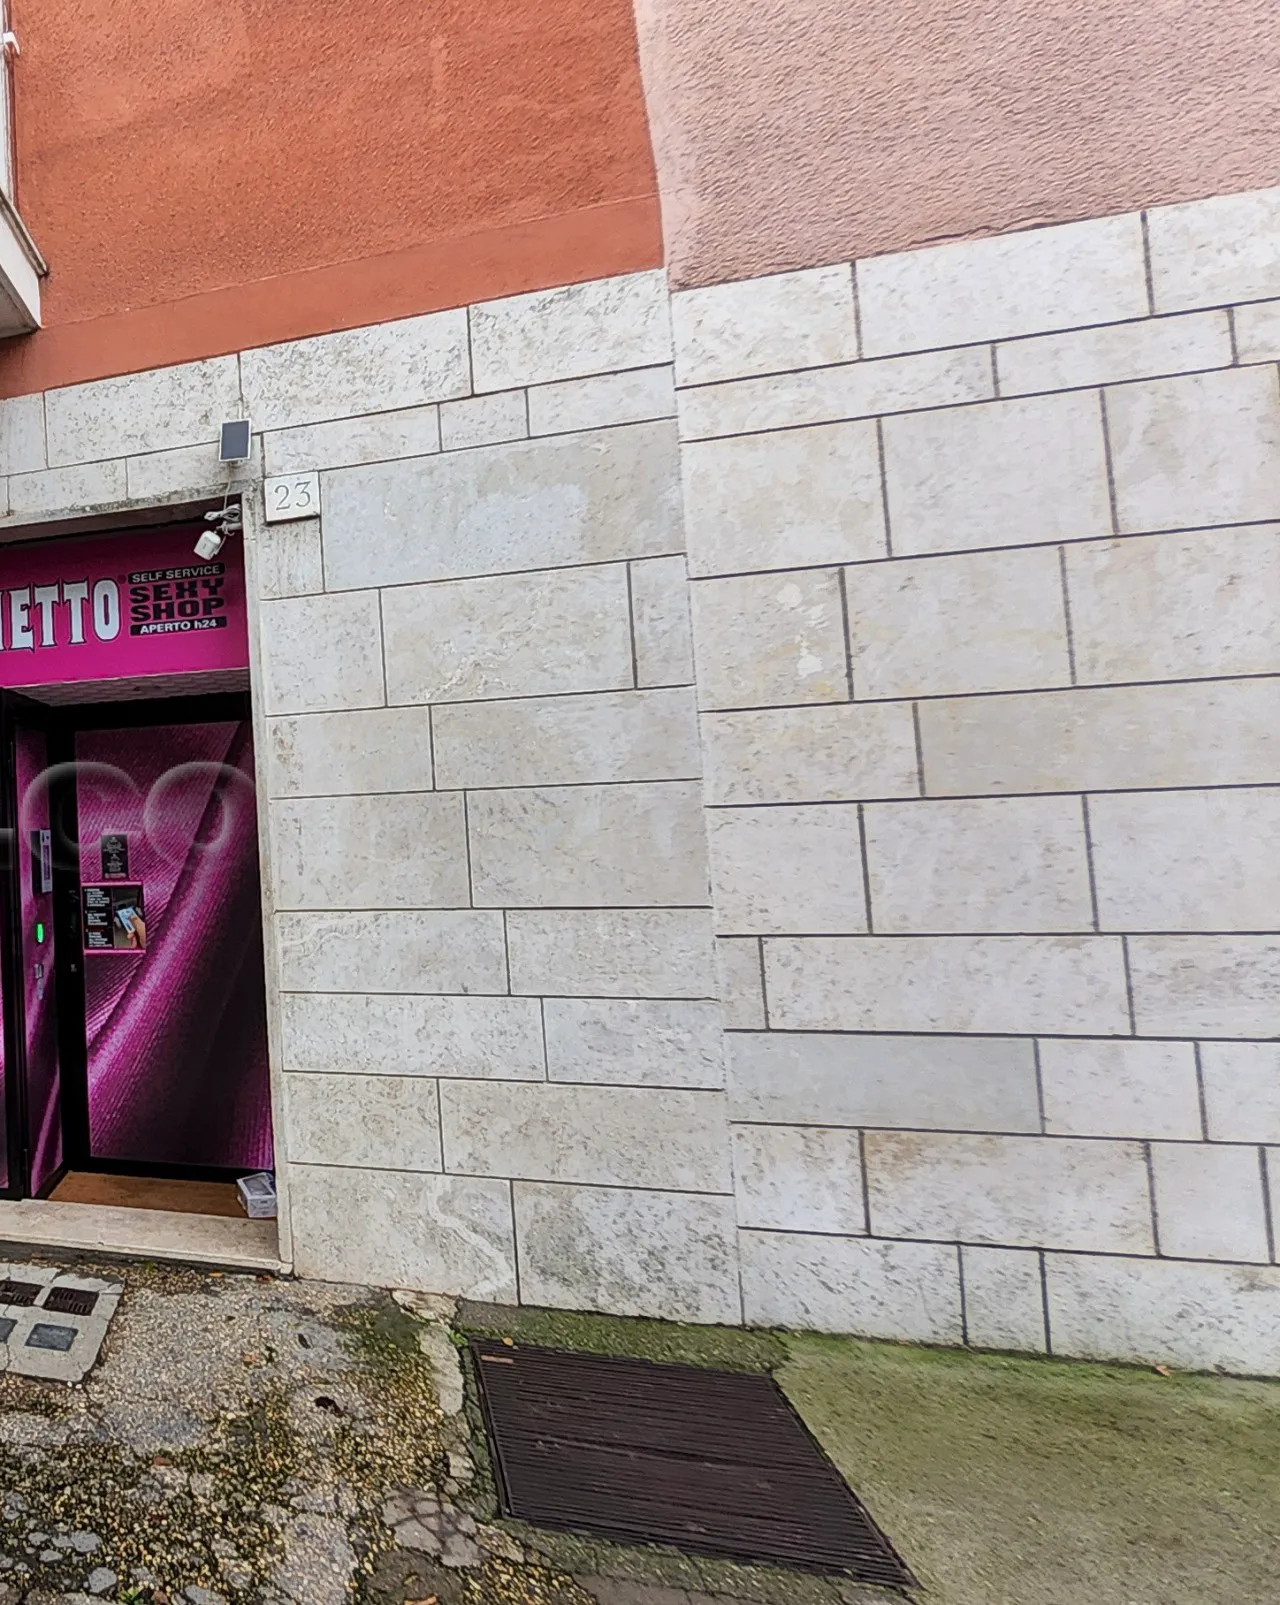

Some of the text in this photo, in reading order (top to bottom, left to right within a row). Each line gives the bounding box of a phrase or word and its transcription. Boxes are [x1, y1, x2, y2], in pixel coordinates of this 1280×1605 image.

[274, 481, 312, 511] 23
[132, 564, 220, 584] SELF SERVICE
[129, 577, 225, 604] SEXY
[130, 597, 225, 623] SHOP
[140, 618, 218, 635] APERTO h24
